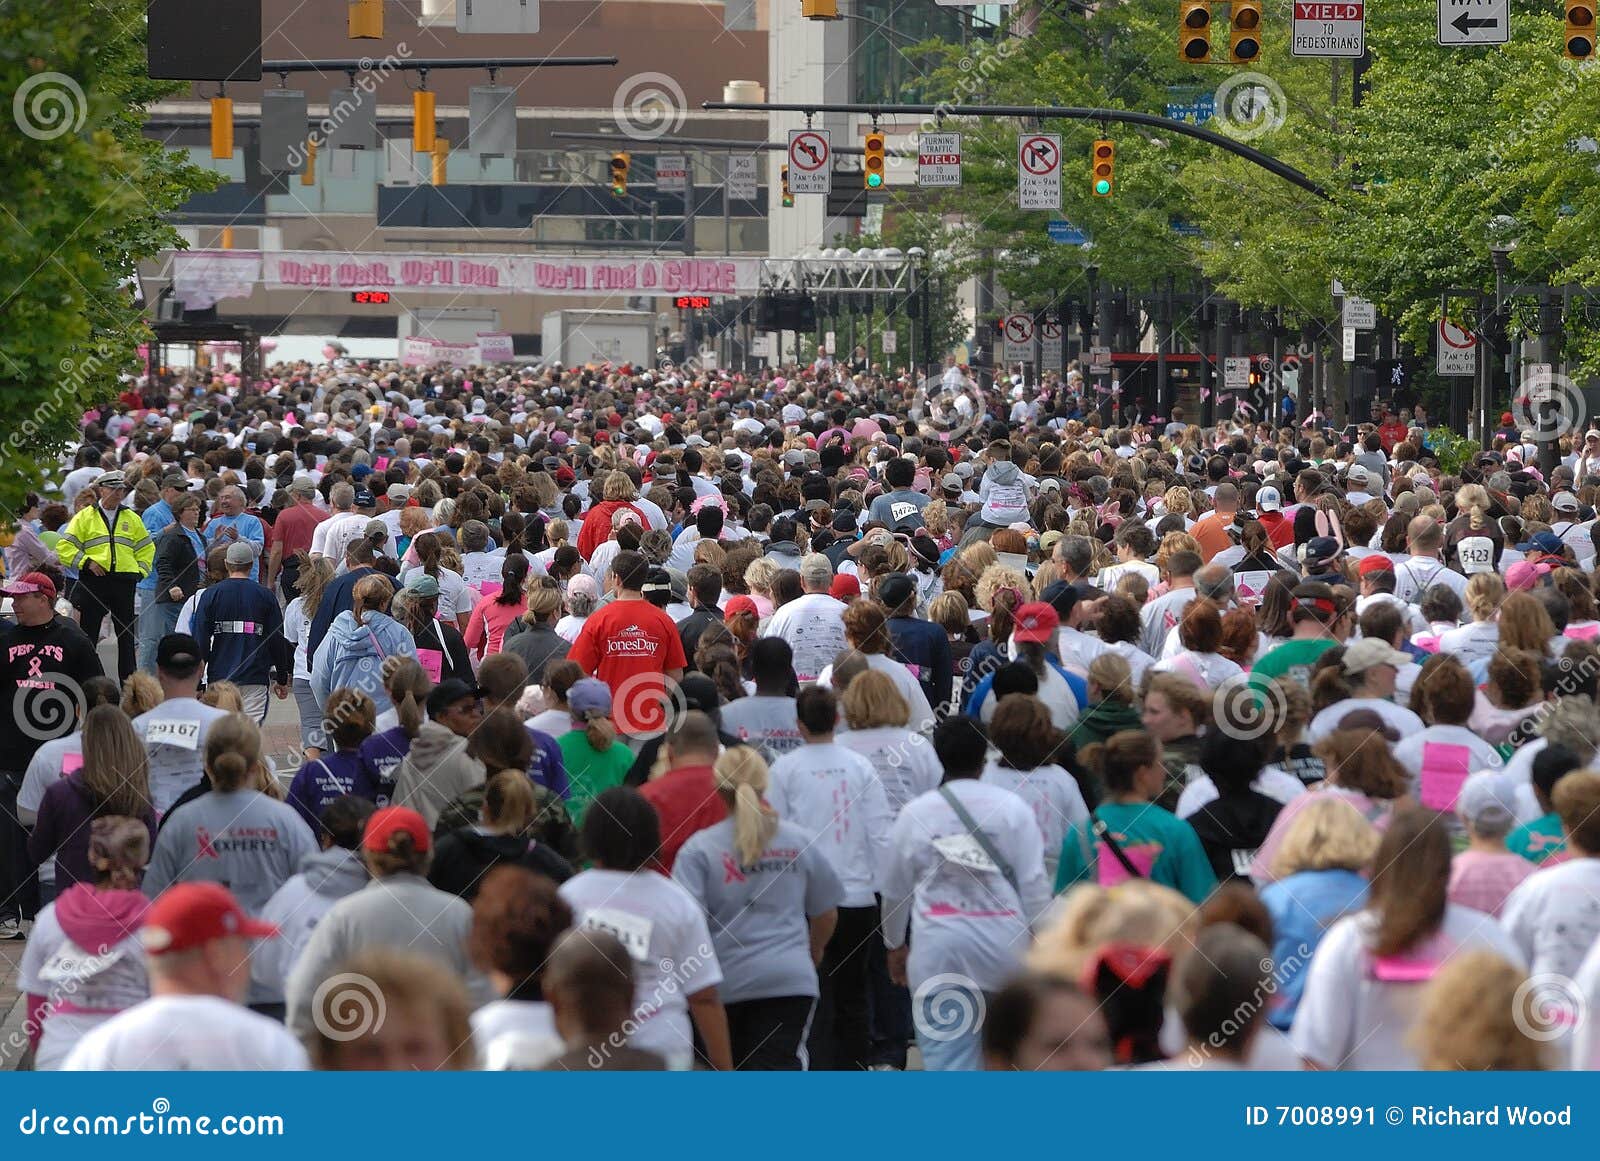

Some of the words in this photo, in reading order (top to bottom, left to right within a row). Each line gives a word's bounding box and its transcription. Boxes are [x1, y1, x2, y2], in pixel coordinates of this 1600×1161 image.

[1300, 5, 1358, 19] YIELD
[1322, 23, 1334, 35] TO
[1296, 36, 1359, 50] PEDESTRIANS
[924, 136, 955, 145] TURNING
[926, 145, 953, 153] TRAFFIC
[922, 155, 957, 164] YIELD
[920, 174, 959, 182] PEDESTRIANS
[279, 260, 332, 286] We'll
[401, 259, 454, 285] We'll
[459, 260, 499, 288] Run
[534, 261, 587, 290] We'll
[592, 262, 638, 290] Find
[641, 262, 657, 288] A
[661, 260, 737, 294] CURE
[1463, 549, 1489, 562] 5423
[606, 638, 659, 655] JonesDay
[762, 849, 798, 858] ANCER
